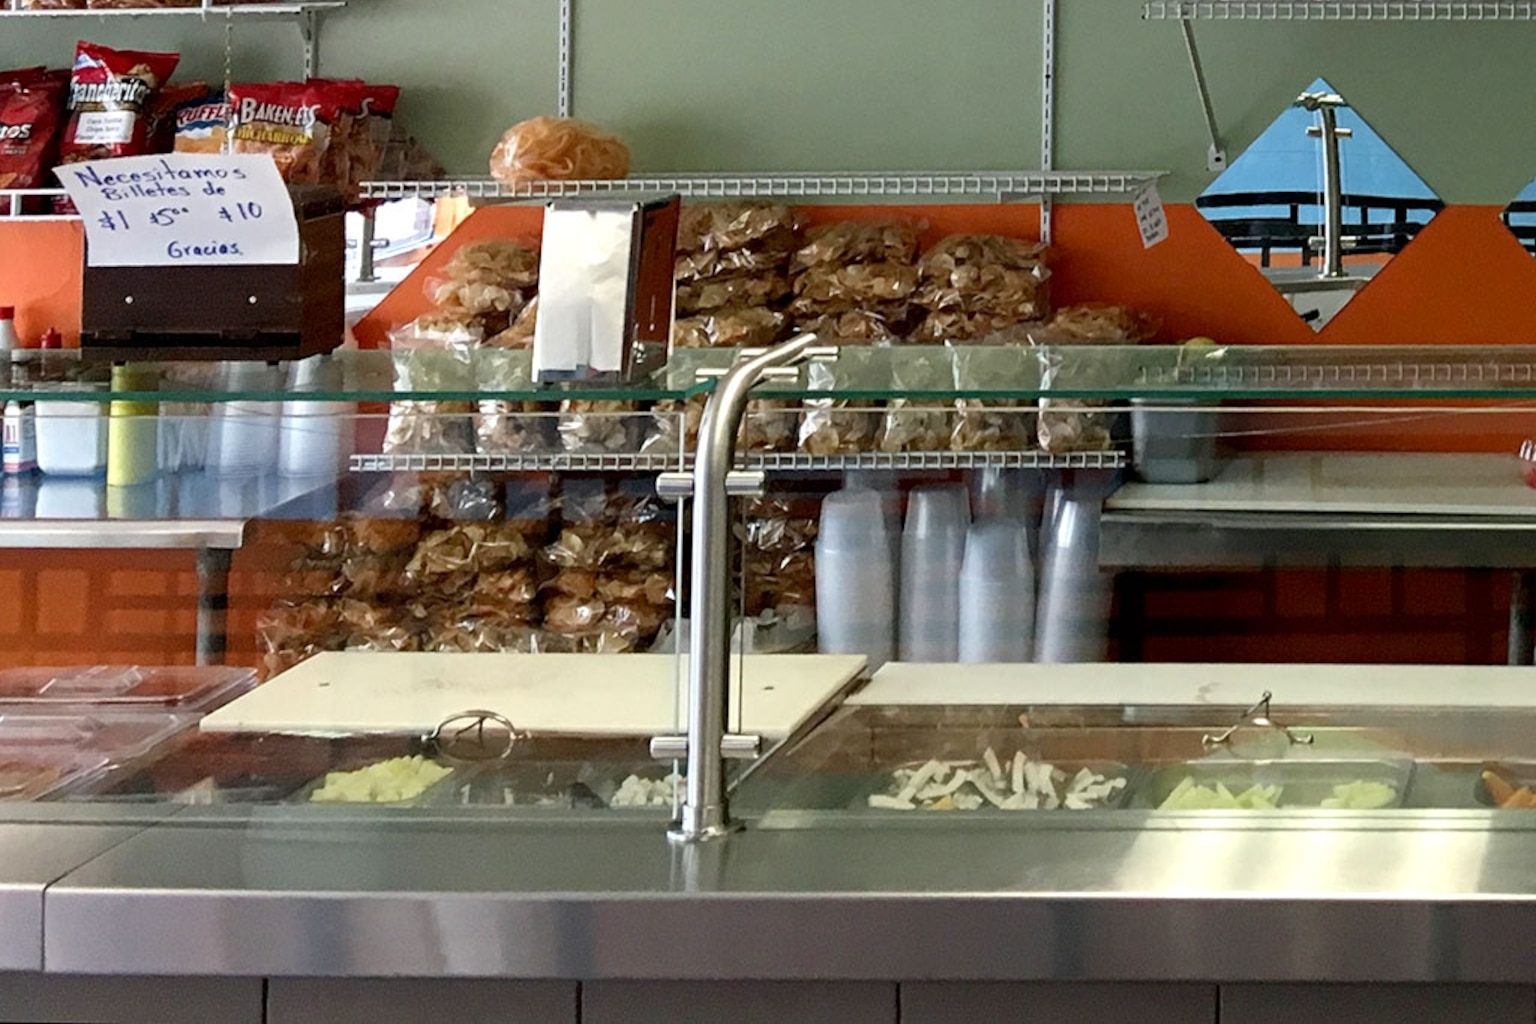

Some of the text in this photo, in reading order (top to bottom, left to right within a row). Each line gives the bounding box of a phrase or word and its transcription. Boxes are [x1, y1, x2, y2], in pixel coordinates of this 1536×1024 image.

[74, 159, 247, 187] Necesitamos
[102, 182, 225, 202] Billetes de
[98, 210, 129, 230] $1
[219, 202, 262, 222] $10
